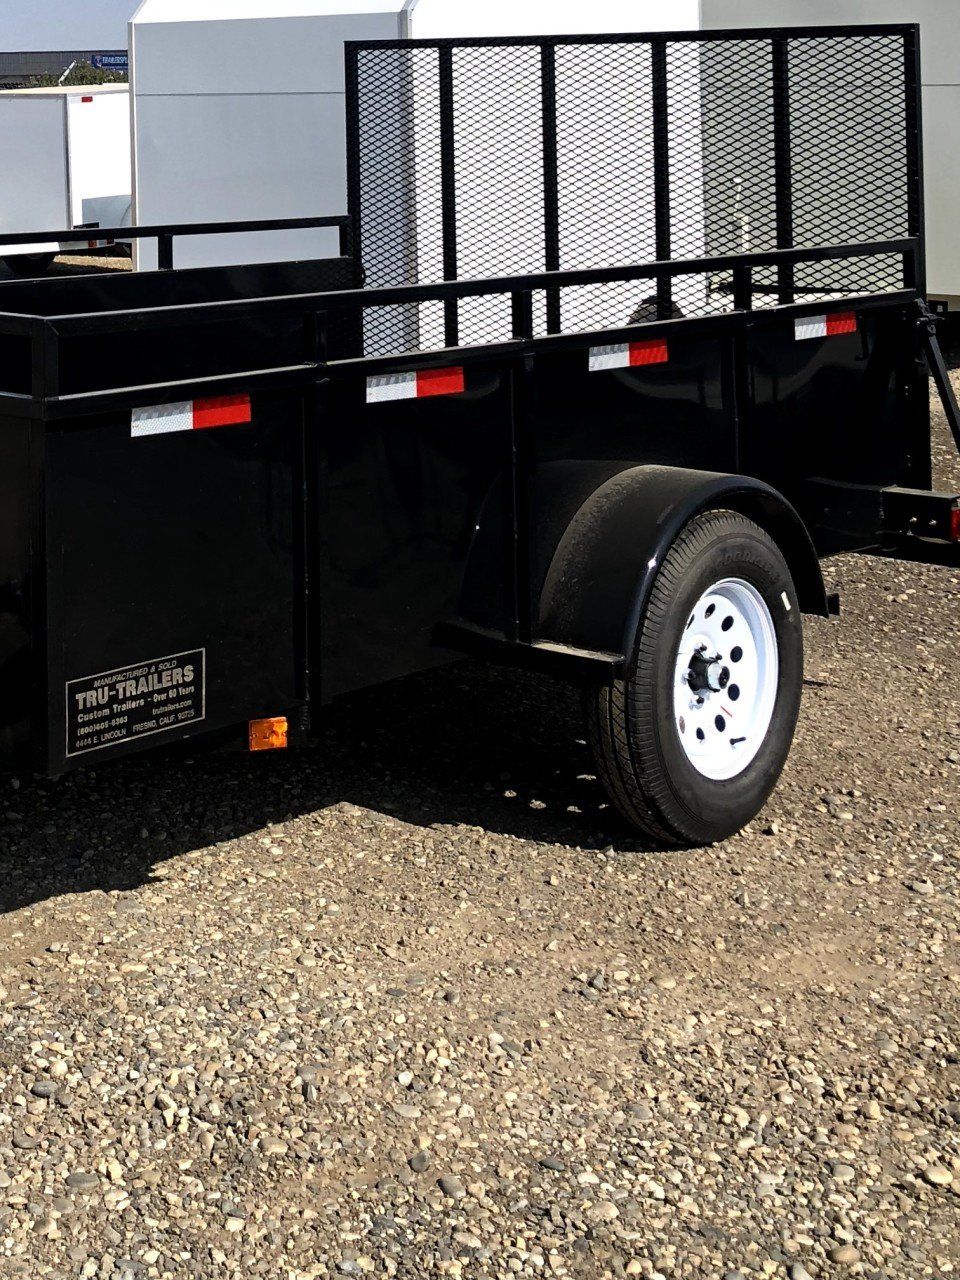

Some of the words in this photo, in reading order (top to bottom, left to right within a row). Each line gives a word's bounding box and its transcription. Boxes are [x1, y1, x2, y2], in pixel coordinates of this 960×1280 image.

[75, 664, 194, 710] TRU-TRAILERS
[93, 669, 148, 688] MANUFACTURED
[150, 665, 156, 673] &
[158, 660, 177, 671] SOLD
[77, 708, 110, 723] Custom
[112, 698, 145, 713] Trailers
[153, 692, 167, 702] Over
[178, 685, 195, 696] Years
[100, 728, 127, 742] LINCOLN
